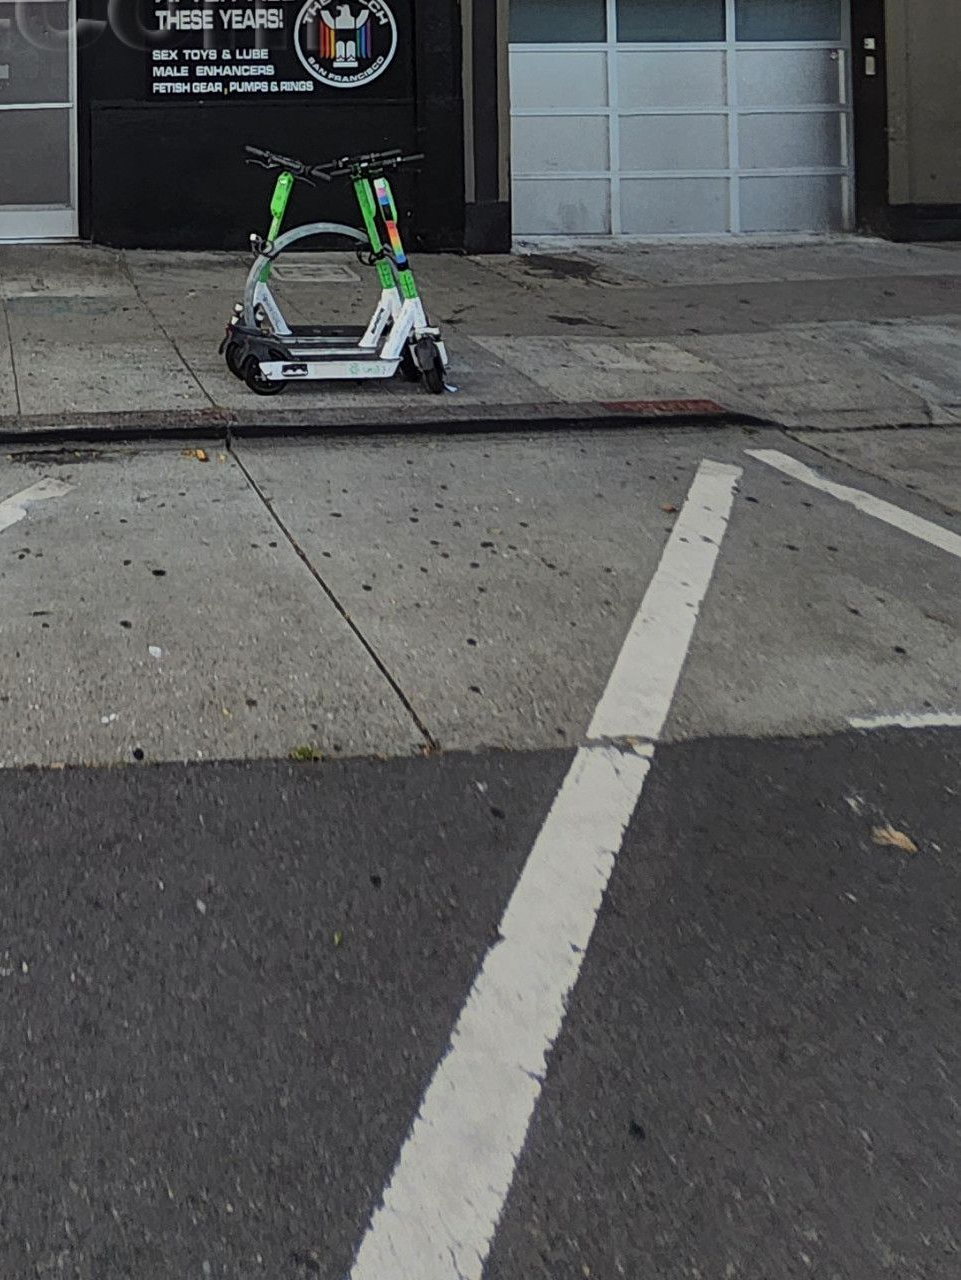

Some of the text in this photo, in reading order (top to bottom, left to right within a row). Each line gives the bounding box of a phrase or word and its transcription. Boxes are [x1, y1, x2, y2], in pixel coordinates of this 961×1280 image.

[155, 9, 284, 30] THESE YEARS!
[152, 48, 269, 61] SEX TOYS & LUBE
[152, 65, 275, 77] MALE ENHANCERS
[307, 55, 385, 82] SAN FRANCISCO
[152, 82, 191, 94] FETISH
[229, 81, 269, 93] PUMPS
[270, 81, 279, 92] &
[280, 81, 314, 93] RINGS
